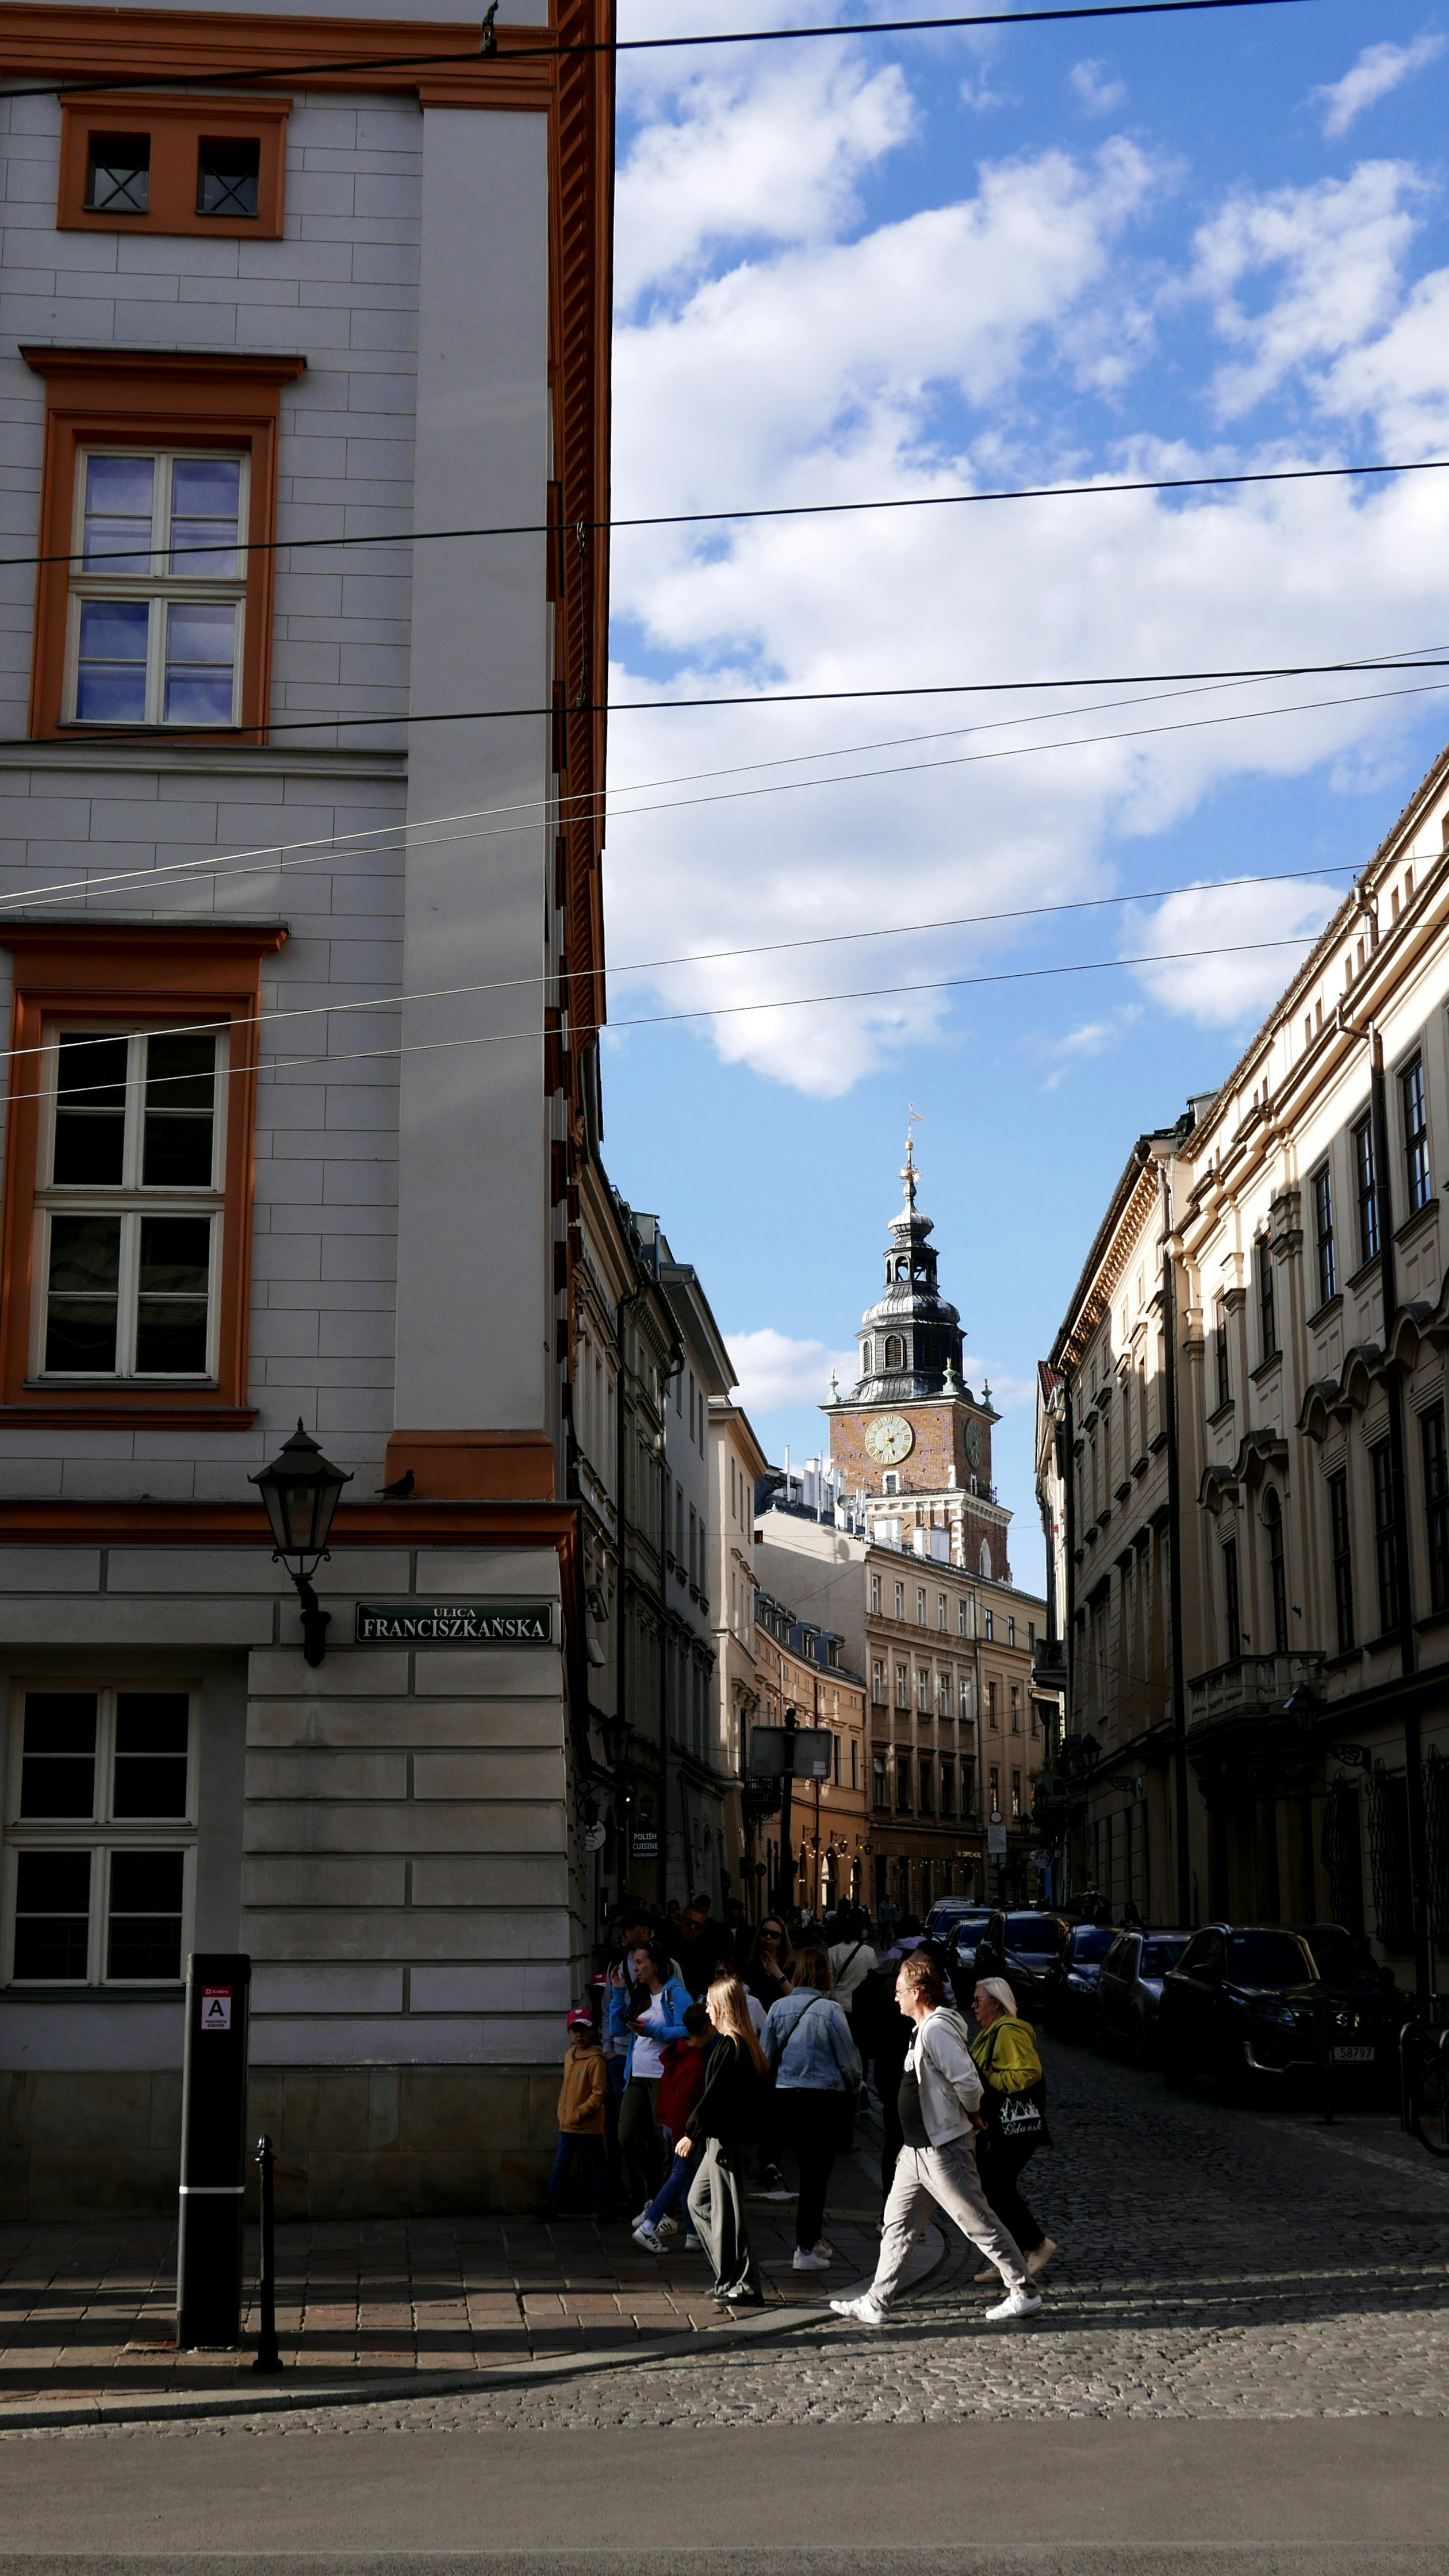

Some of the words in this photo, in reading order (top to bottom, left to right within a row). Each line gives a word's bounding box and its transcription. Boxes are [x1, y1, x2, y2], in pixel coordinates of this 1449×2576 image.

[434, 1608, 476, 1617] ULICA
[363, 1617, 545, 1637] FRANCISZKAŃSKA
[208, 2000, 224, 2017] A
[1340, 2048, 1372, 2058] 58797
[1002, 2119, 1041, 2136] Gdańsk
